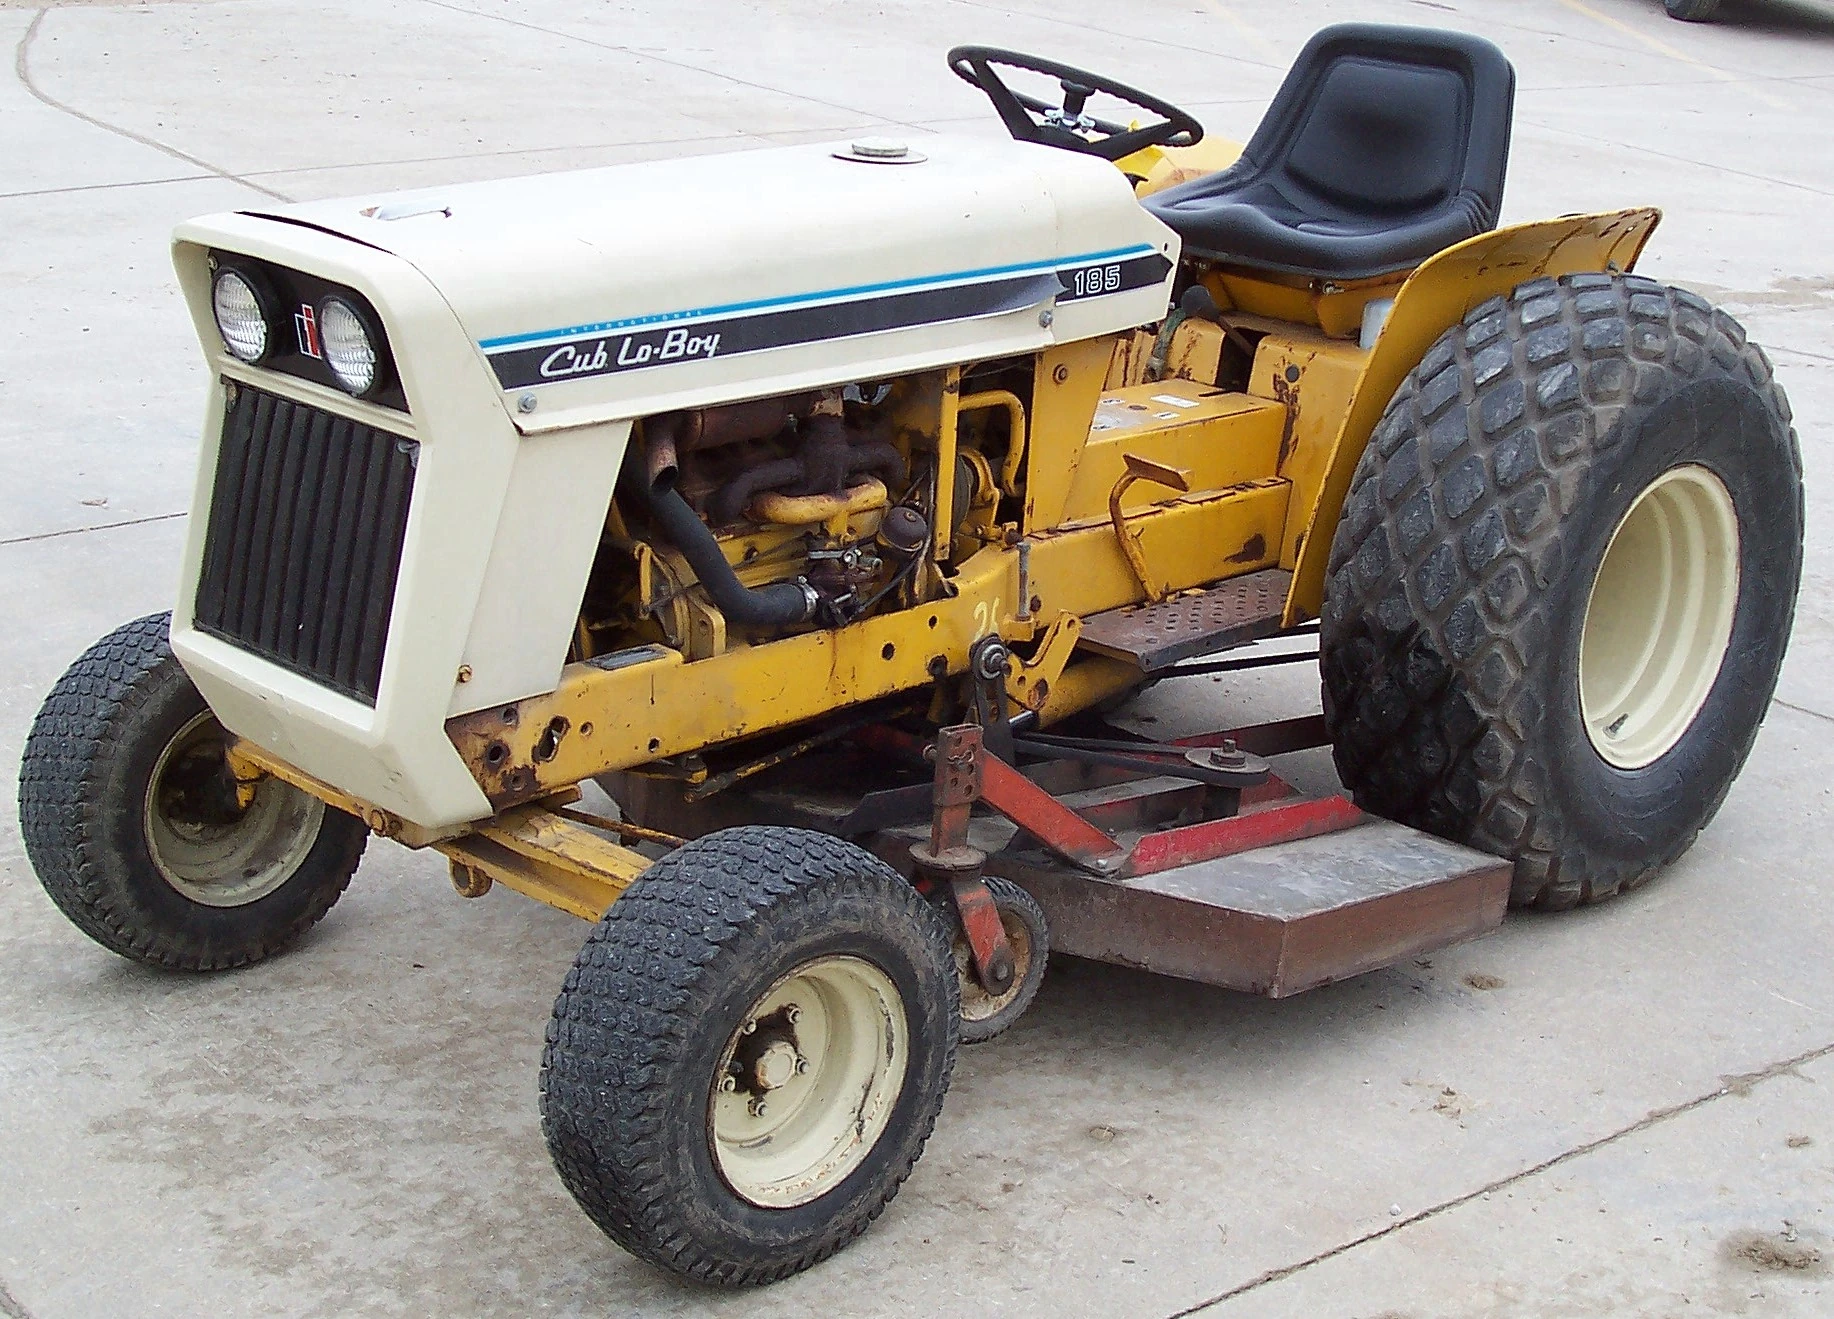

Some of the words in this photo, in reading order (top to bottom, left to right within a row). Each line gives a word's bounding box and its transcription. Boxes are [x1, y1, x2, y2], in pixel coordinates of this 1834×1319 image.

[1074, 264, 1120, 296] 185
[540, 340, 607, 377] Cub
[617, 328, 720, 366] Lo-Boy
